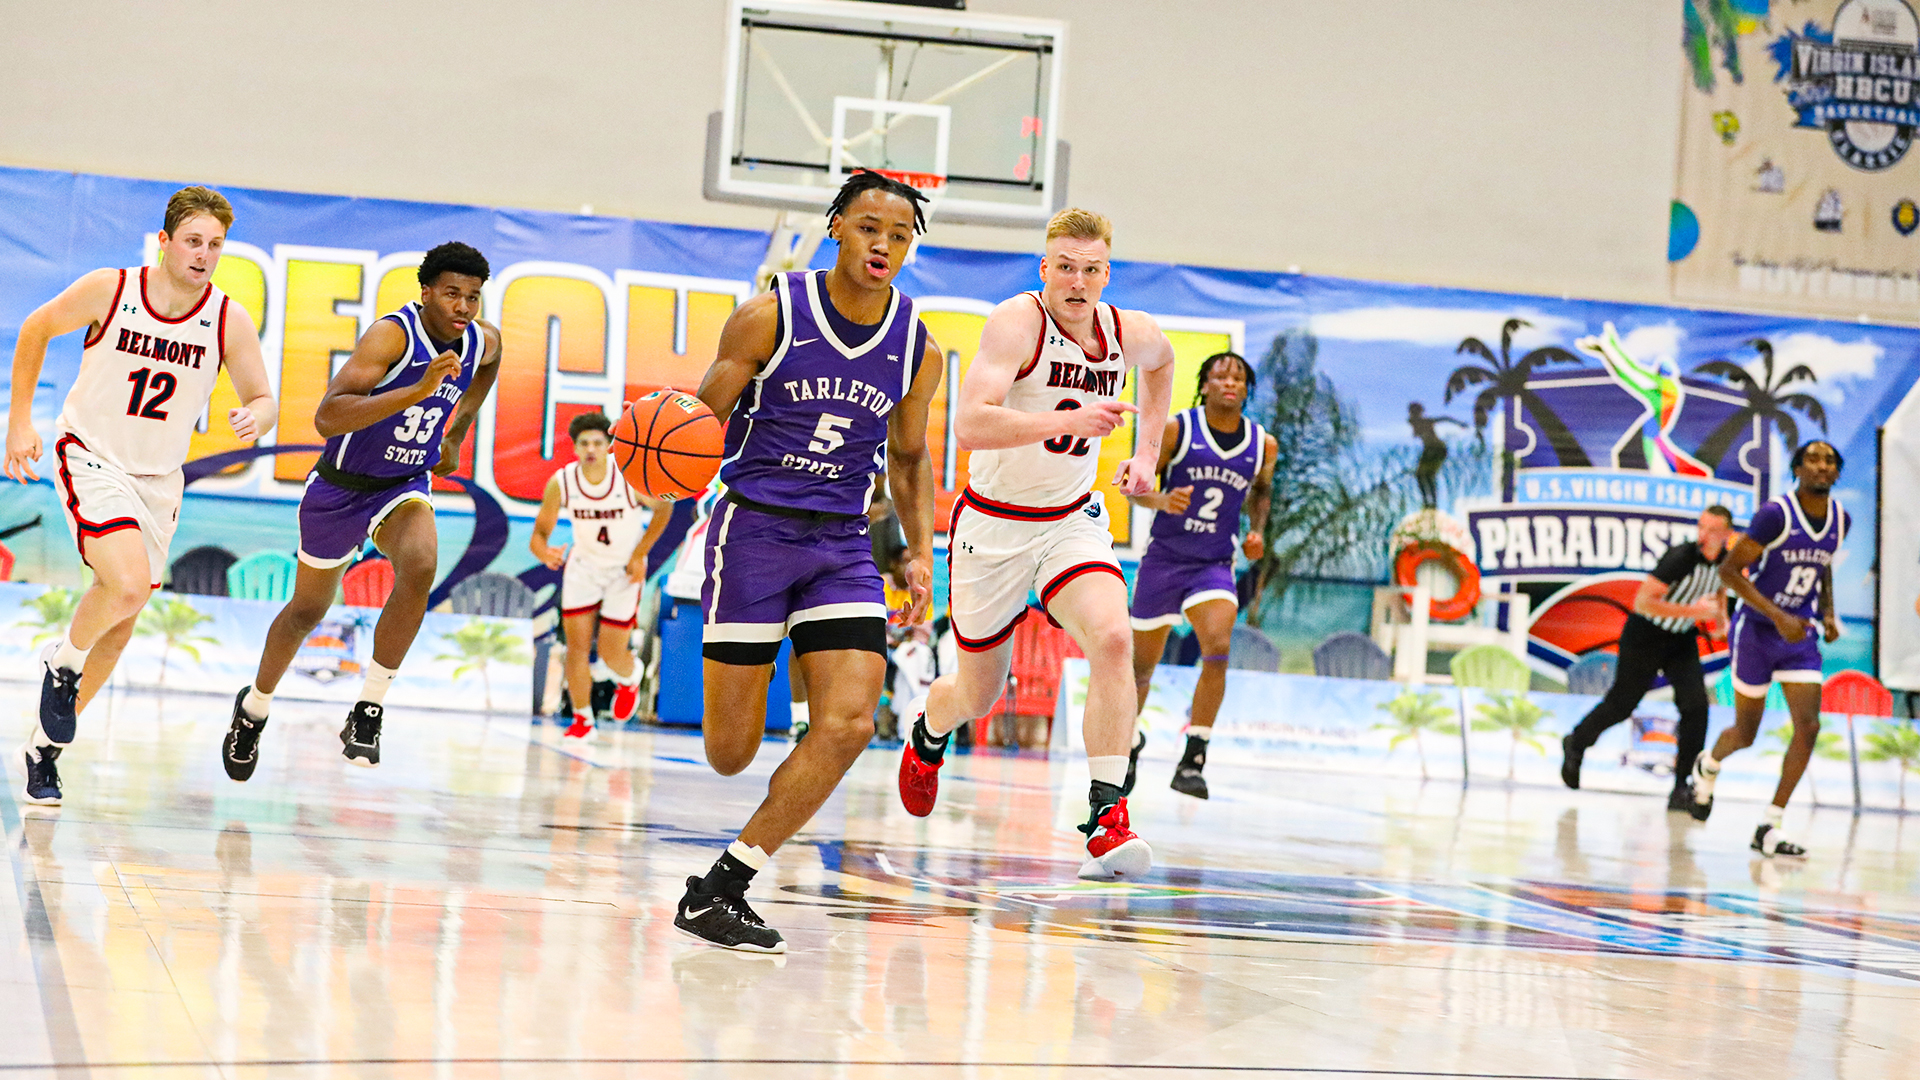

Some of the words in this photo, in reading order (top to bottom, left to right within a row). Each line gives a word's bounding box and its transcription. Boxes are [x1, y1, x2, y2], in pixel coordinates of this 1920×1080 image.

[1835, 75, 1911, 104] HBCU
[116, 327, 206, 369] BELMONT
[126, 366, 178, 421] 12
[784, 377, 894, 418] TARLETON
[393, 405, 444, 444] 33
[808, 412, 854, 455] 5
[384, 445, 427, 465] STATE
[1198, 487, 1224, 521] 2
[1656, 483, 1747, 515] ISLANDS
[597, 526, 610, 546] 4
[1784, 565, 1817, 596] 13
